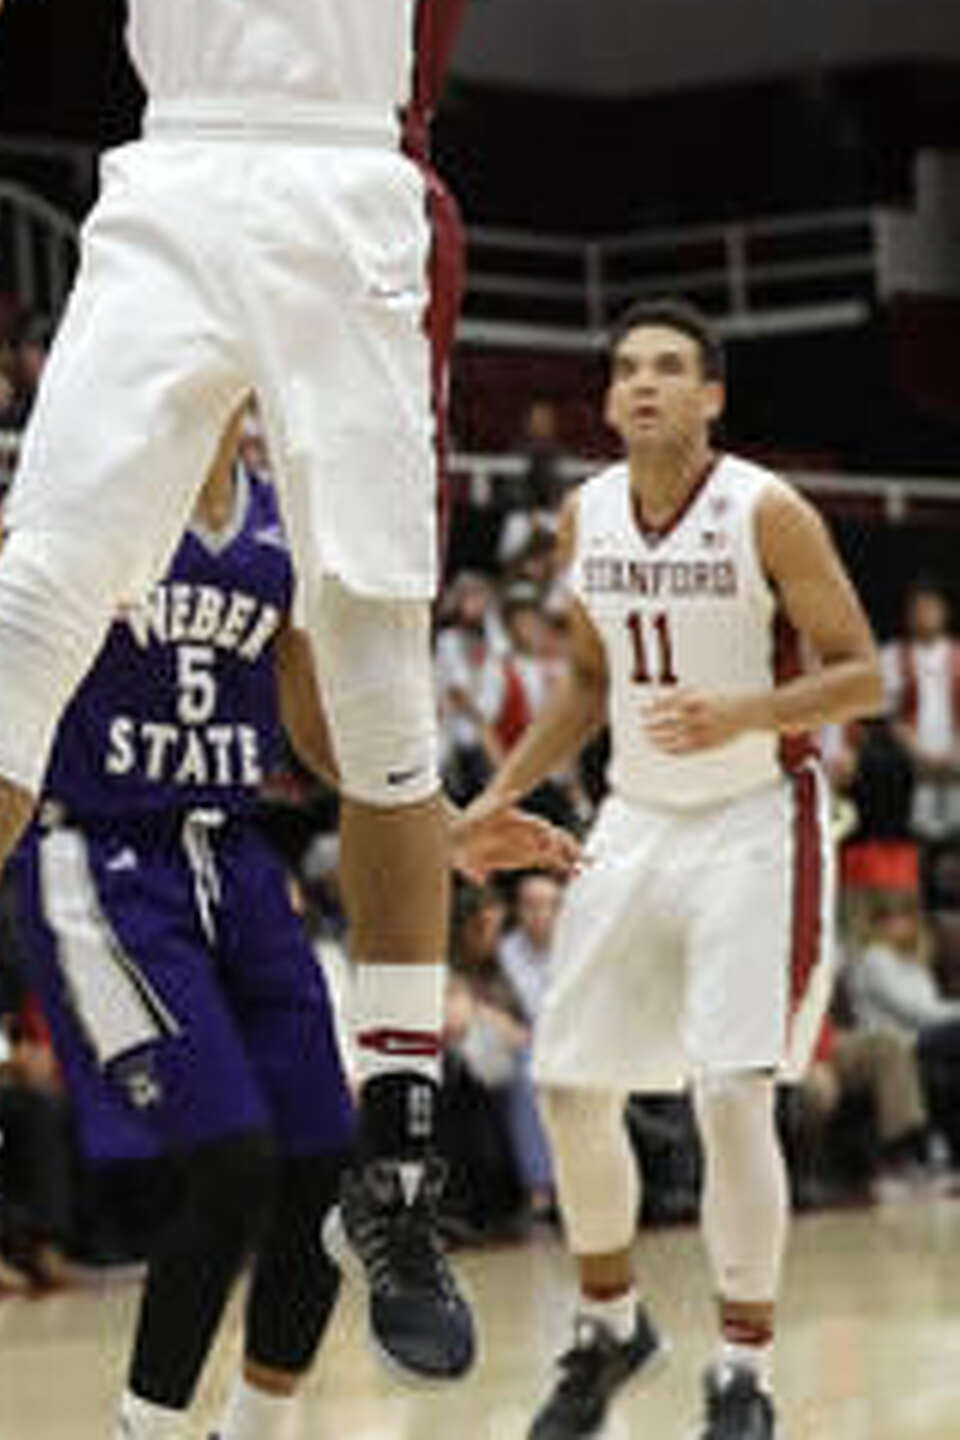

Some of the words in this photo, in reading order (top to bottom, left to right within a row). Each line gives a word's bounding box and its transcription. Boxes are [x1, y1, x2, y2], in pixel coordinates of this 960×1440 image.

[583, 558, 738, 596] STANFORD
[627, 611, 678, 684] 11
[176, 645, 216, 724] 5
[104, 715, 263, 786] STATE
